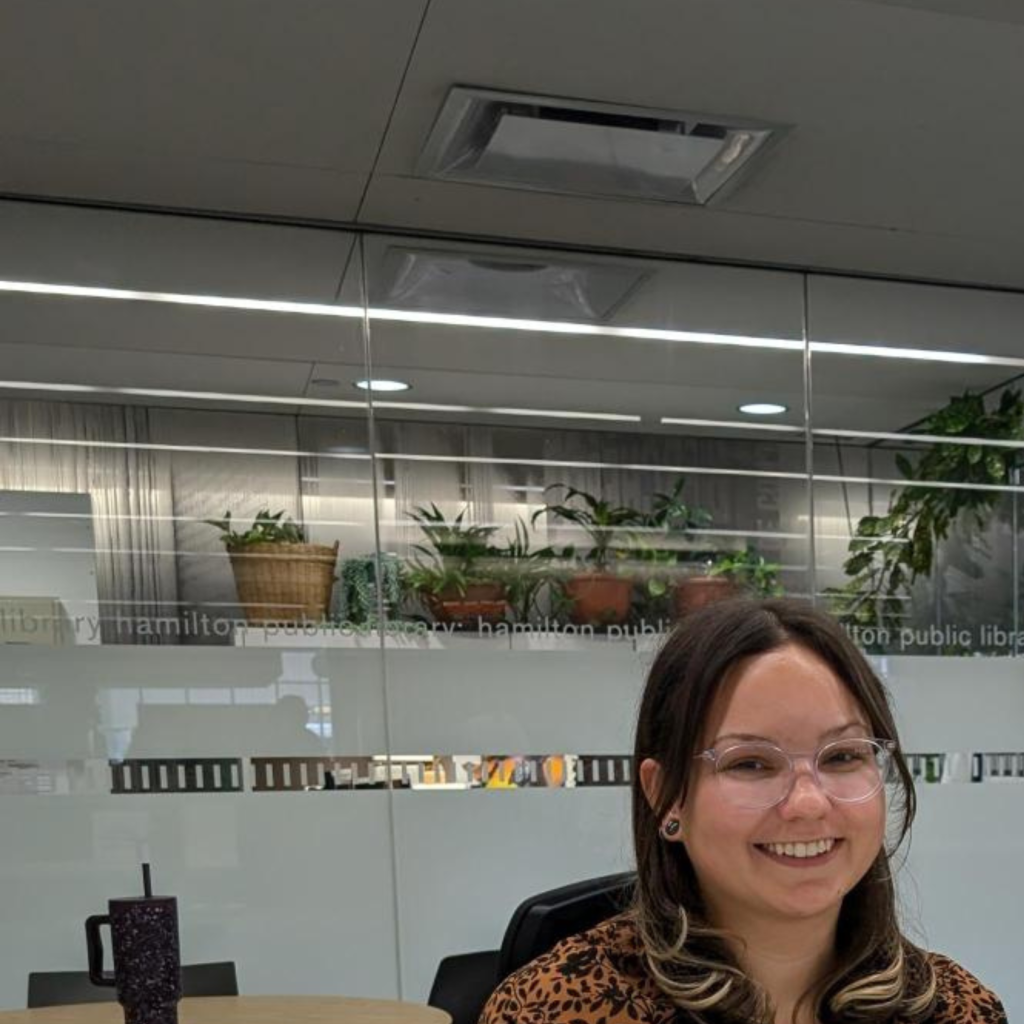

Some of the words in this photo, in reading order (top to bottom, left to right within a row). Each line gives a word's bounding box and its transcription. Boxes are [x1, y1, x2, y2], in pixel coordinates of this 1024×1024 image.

[116, 610, 249, 639] hamilton
[478, 615, 594, 640] hamilton
[607, 618, 672, 645] publi
[900, 624, 972, 651] public
